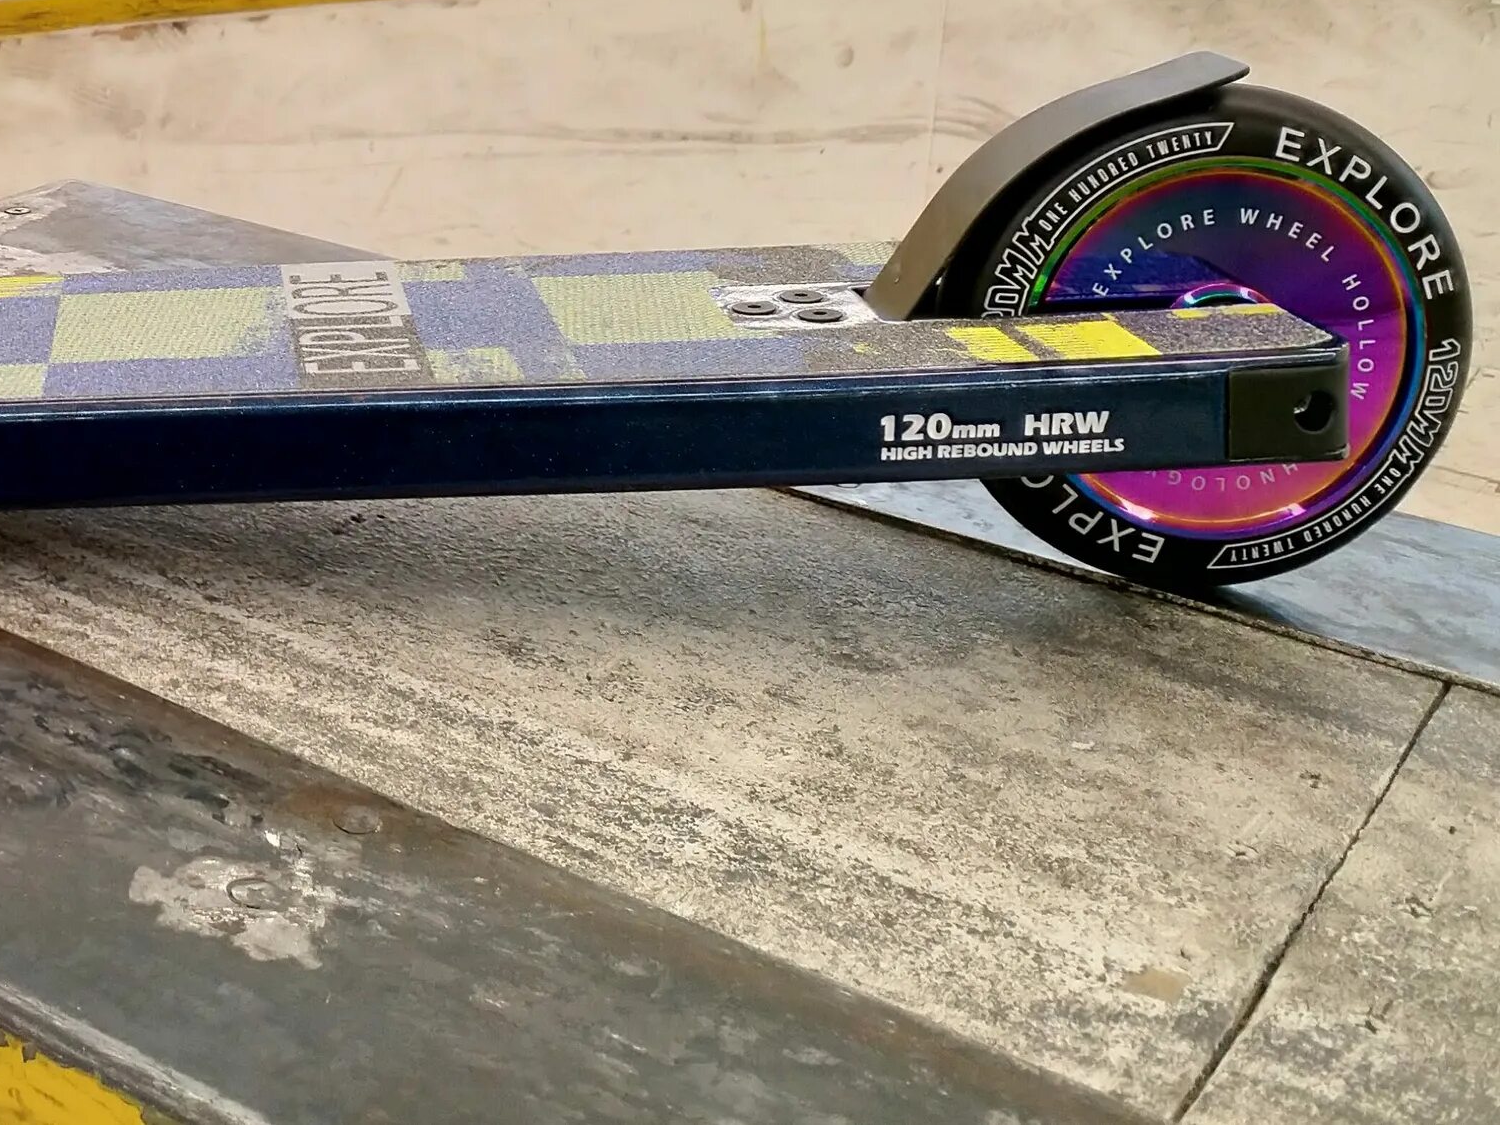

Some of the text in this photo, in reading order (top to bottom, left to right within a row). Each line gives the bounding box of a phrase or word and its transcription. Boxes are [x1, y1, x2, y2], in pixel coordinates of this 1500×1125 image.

[1038, 201, 1068, 232] ONE
[1068, 152, 1139, 203] HUNDRED
[1145, 130, 1214, 159] TWENTY
[1275, 124, 1454, 301] EXPLORE
[289, 271, 421, 374] EXPLORE
[1092, 208, 1216, 297] EXPLORE
[1240, 207, 1337, 263] WHEEL
[1341, 273, 1376, 401] HOLLOW
[880, 410, 1110, 442] 120mm HRW
[881, 437, 1125, 461] HIGH REBOUND WHEELS
[1376, 468, 1401, 494] ONE
[1304, 495, 1372, 542] HUNDRED
[1230, 538, 1295, 562] TWENTY
